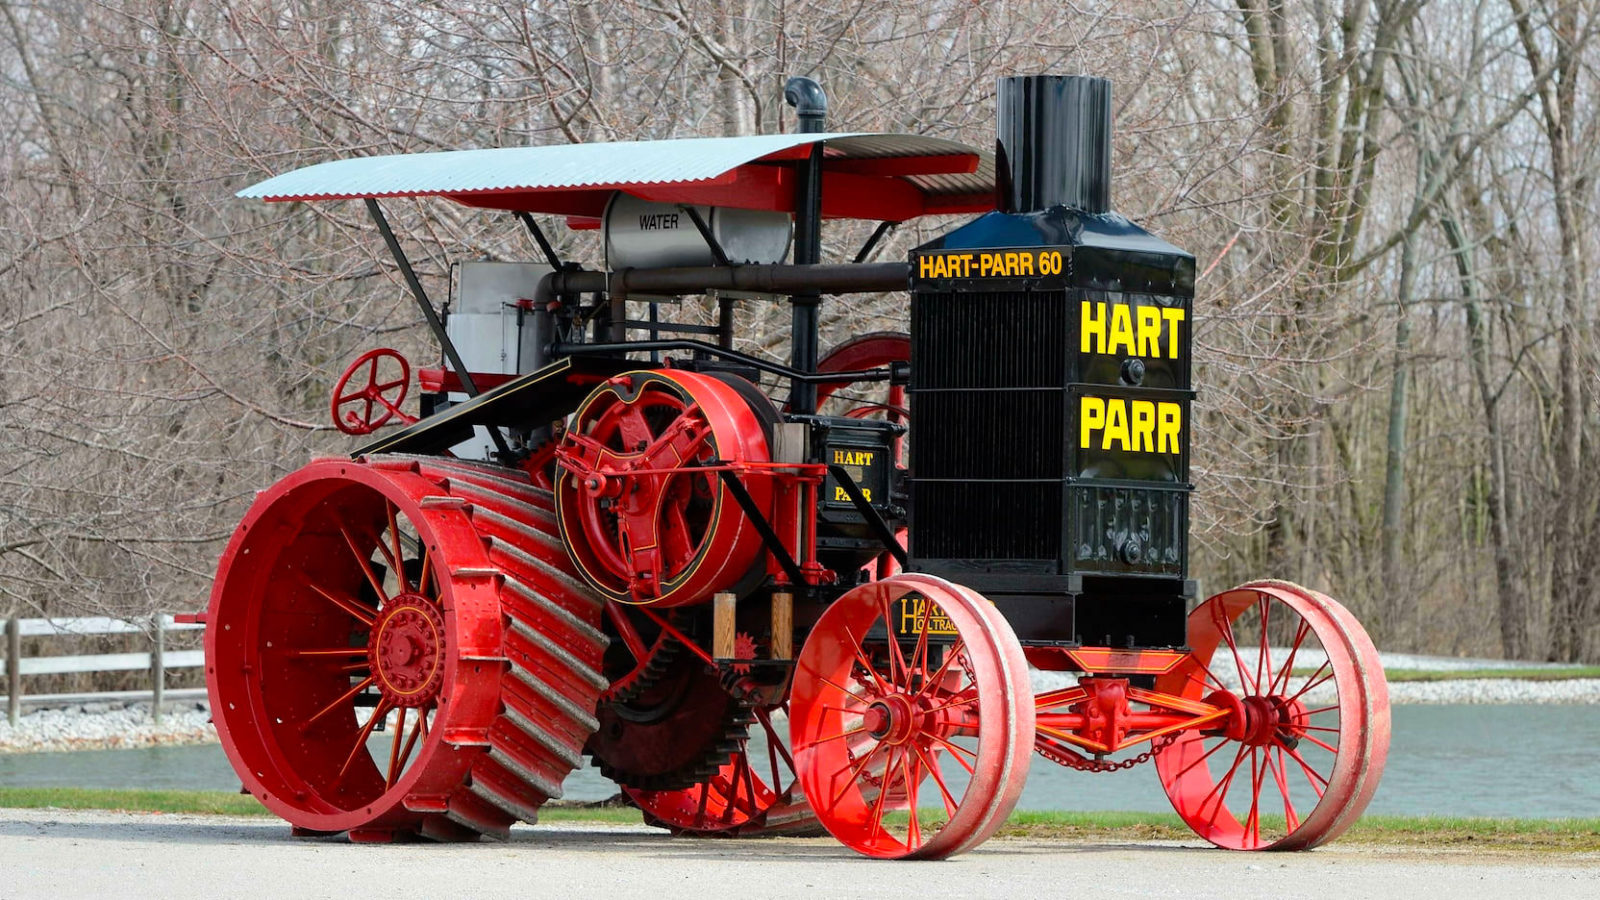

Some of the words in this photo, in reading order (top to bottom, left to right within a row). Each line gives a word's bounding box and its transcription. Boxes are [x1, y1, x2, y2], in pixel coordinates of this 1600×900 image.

[640, 213, 679, 230] WATER
[919, 252, 1034, 279] HART-PARR
[1039, 251, 1062, 275] 60
[1080, 300, 1185, 359] HART
[1080, 396, 1182, 454] PARR
[833, 450, 873, 466] HART
[834, 486, 872, 502] PAR
